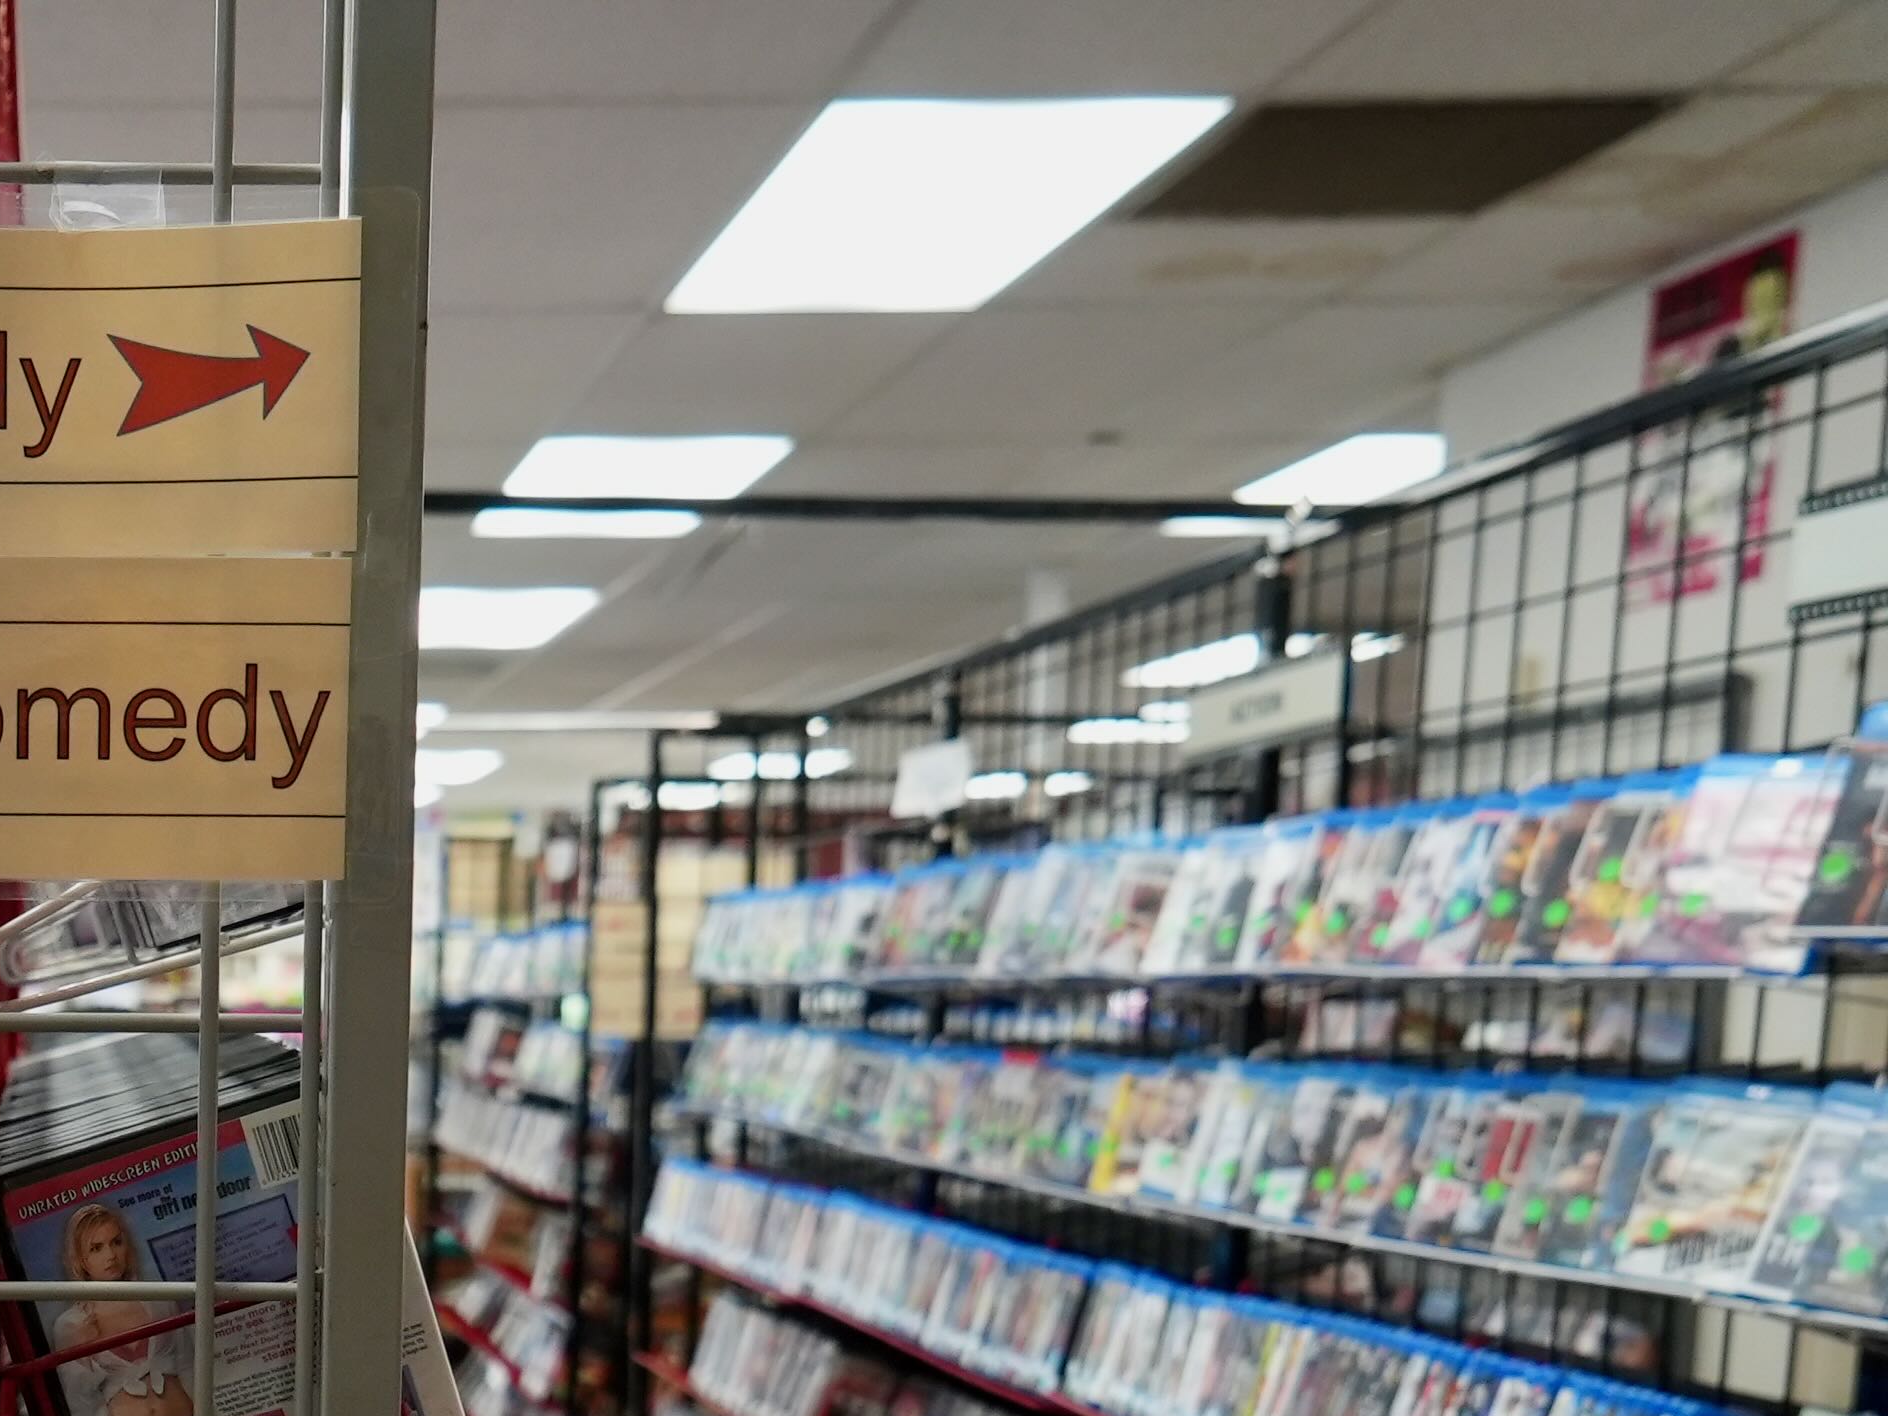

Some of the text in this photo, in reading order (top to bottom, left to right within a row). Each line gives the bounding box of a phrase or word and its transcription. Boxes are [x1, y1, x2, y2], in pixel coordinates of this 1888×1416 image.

[19, 1141, 198, 1220] UNRATED WIDESCREEN EDITI
[118, 1184, 173, 1208] See more of
[154, 1176, 251, 1220] girl ne door
[248, 1305, 276, 1318] more
[215, 1325, 242, 1338] more
[263, 1347, 296, 1362] steam
